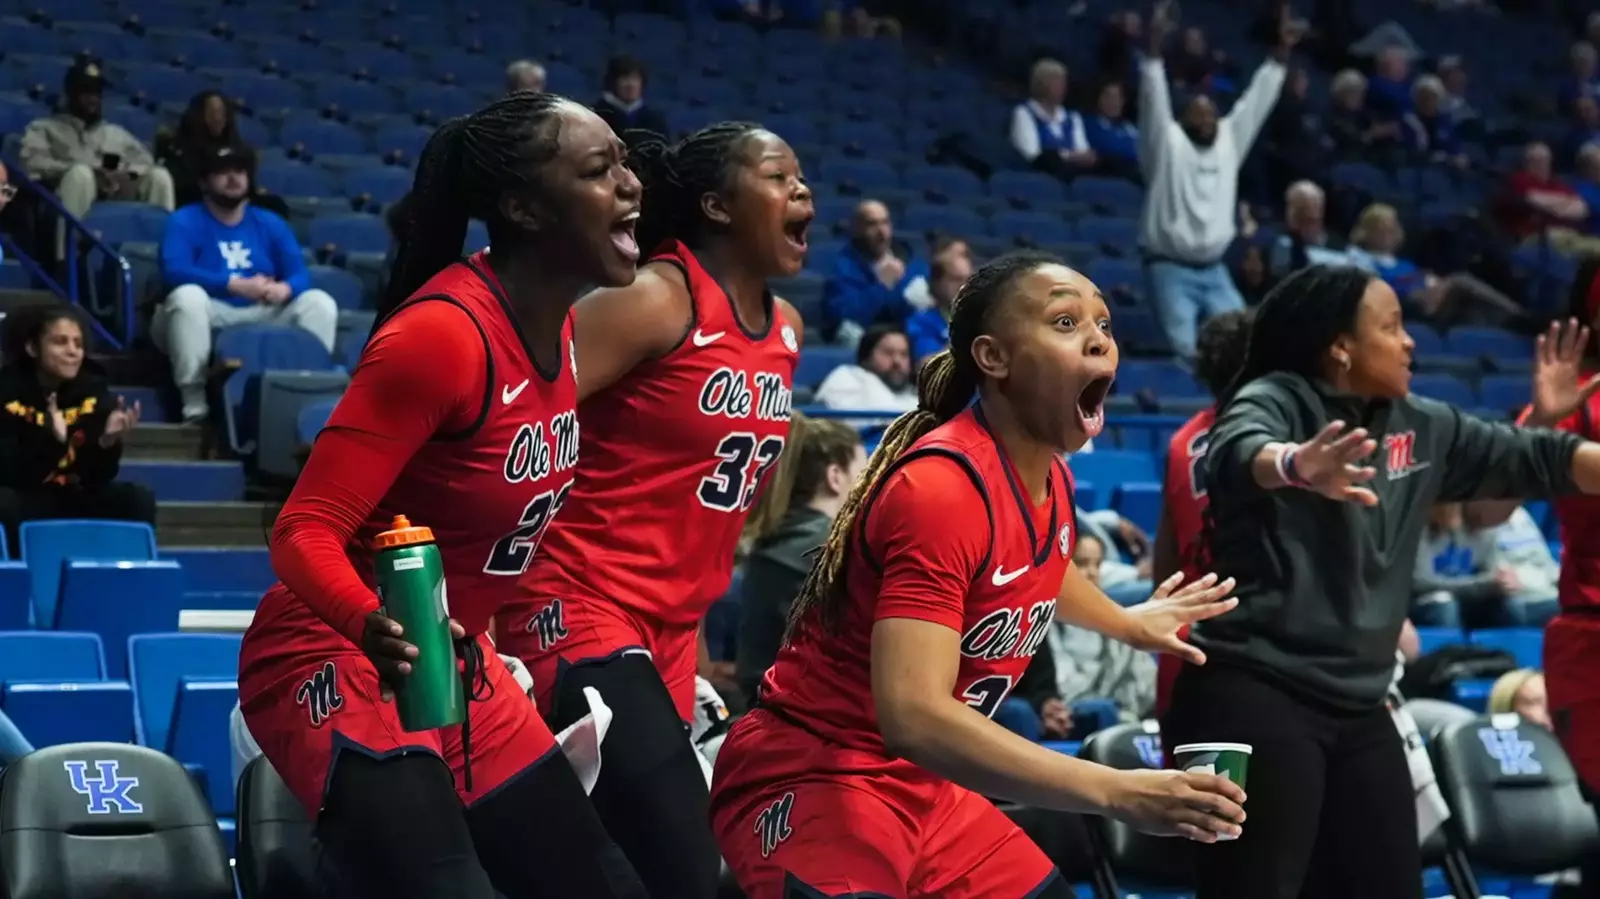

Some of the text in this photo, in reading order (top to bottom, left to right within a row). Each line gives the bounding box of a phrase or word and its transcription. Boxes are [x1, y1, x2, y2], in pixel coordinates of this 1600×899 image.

[698, 367, 752, 419] Ole
[504, 420, 550, 484] Ole
[696, 431, 785, 513] 33
[526, 599, 568, 652] M
[960, 607, 1024, 661] Ole
[297, 661, 343, 726] M
[1477, 727, 1542, 775] UK
[63, 759, 143, 814] UK
[754, 791, 795, 858] M
